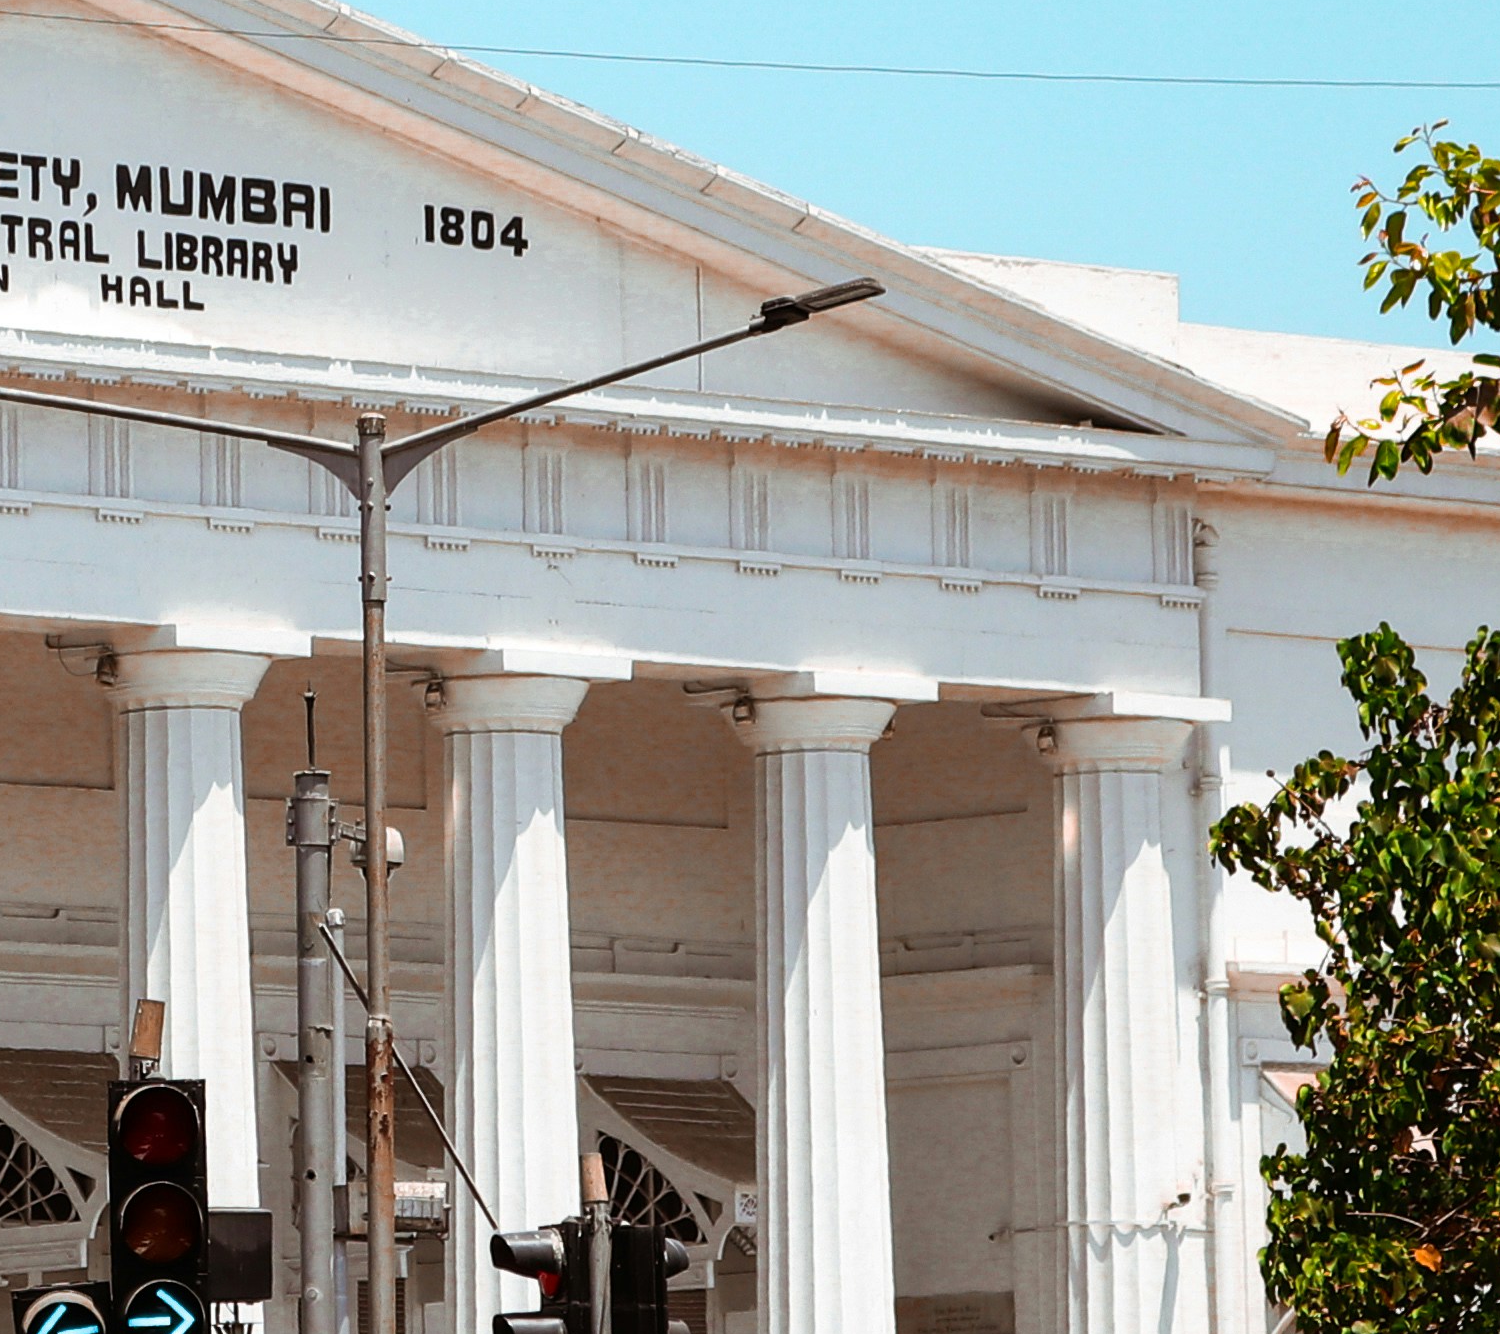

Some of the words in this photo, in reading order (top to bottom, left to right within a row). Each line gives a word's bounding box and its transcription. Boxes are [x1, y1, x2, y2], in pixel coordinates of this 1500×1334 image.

[115, 164, 331, 233] MUMBAI
[137, 229, 298, 285] LIBRARY
[423, 204, 529, 257] 1804
[100, 273, 205, 311] HALL
